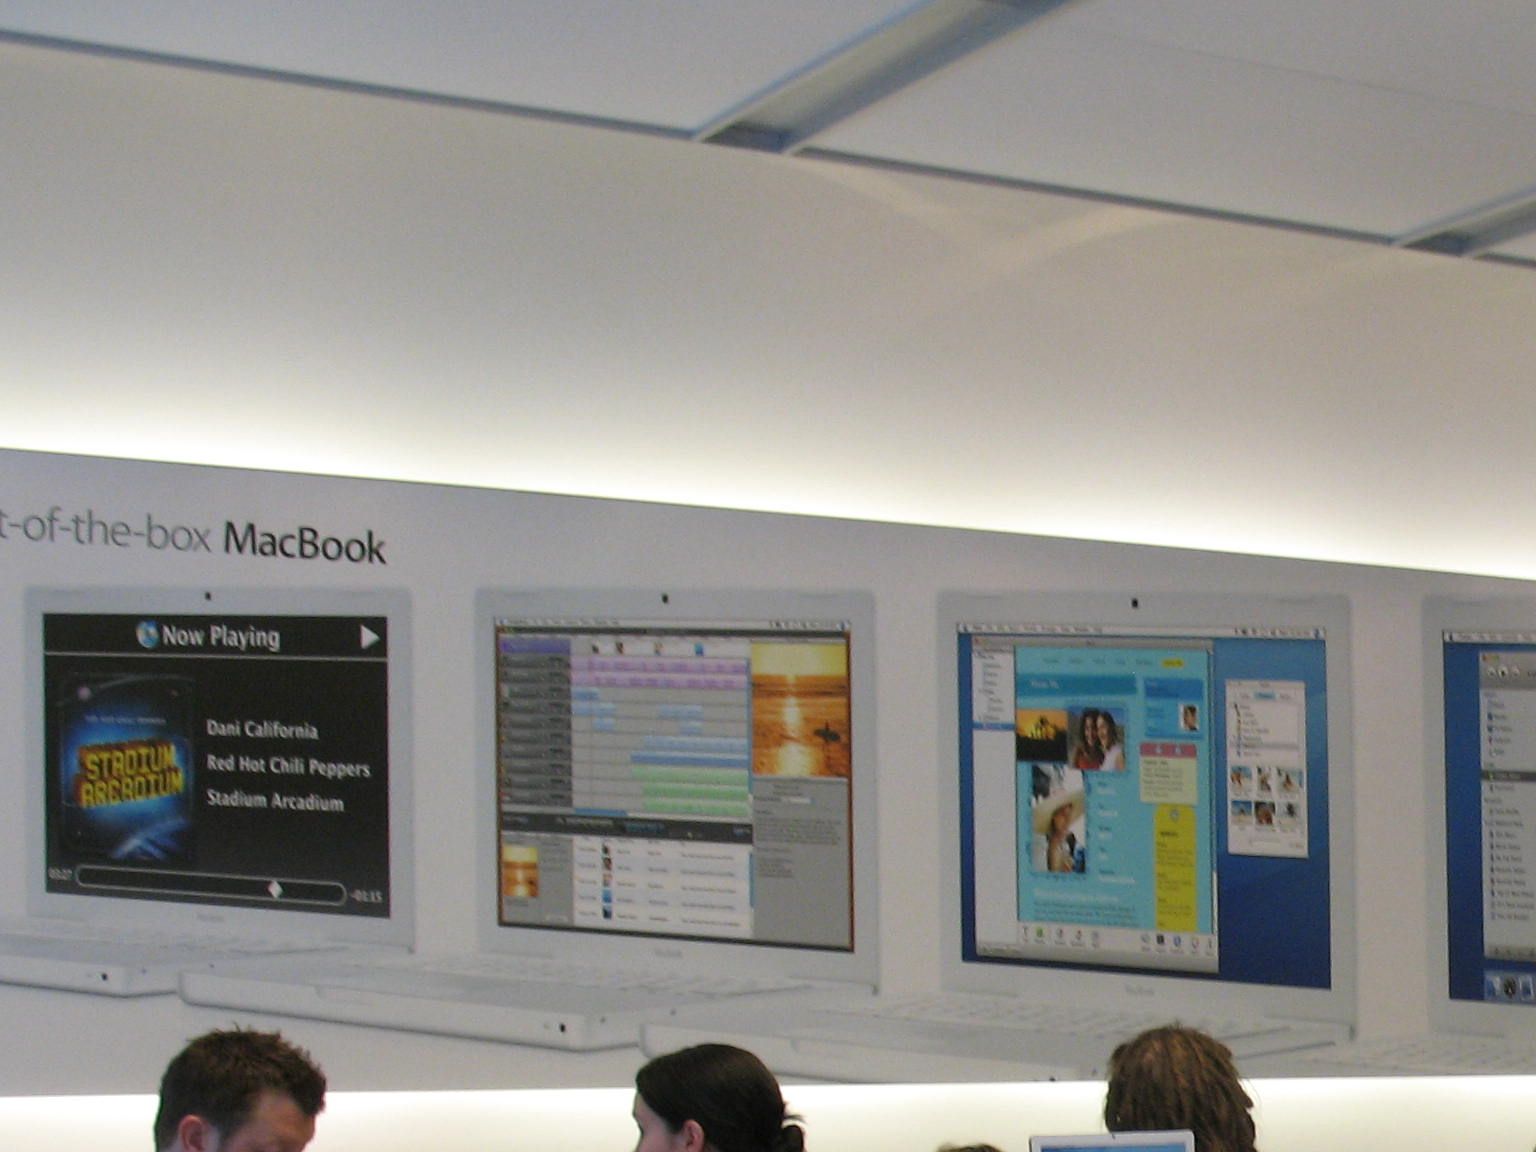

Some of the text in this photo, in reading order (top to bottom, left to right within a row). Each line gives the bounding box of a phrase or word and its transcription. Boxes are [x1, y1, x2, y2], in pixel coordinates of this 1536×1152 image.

[223, 520, 388, 565] MacBook
[162, 623, 280, 652] Now Playing
[206, 719, 320, 741] Dani California
[207, 754, 372, 781] Red Hot Chili Peppers
[206, 788, 345, 813] Stadium Arcadium
